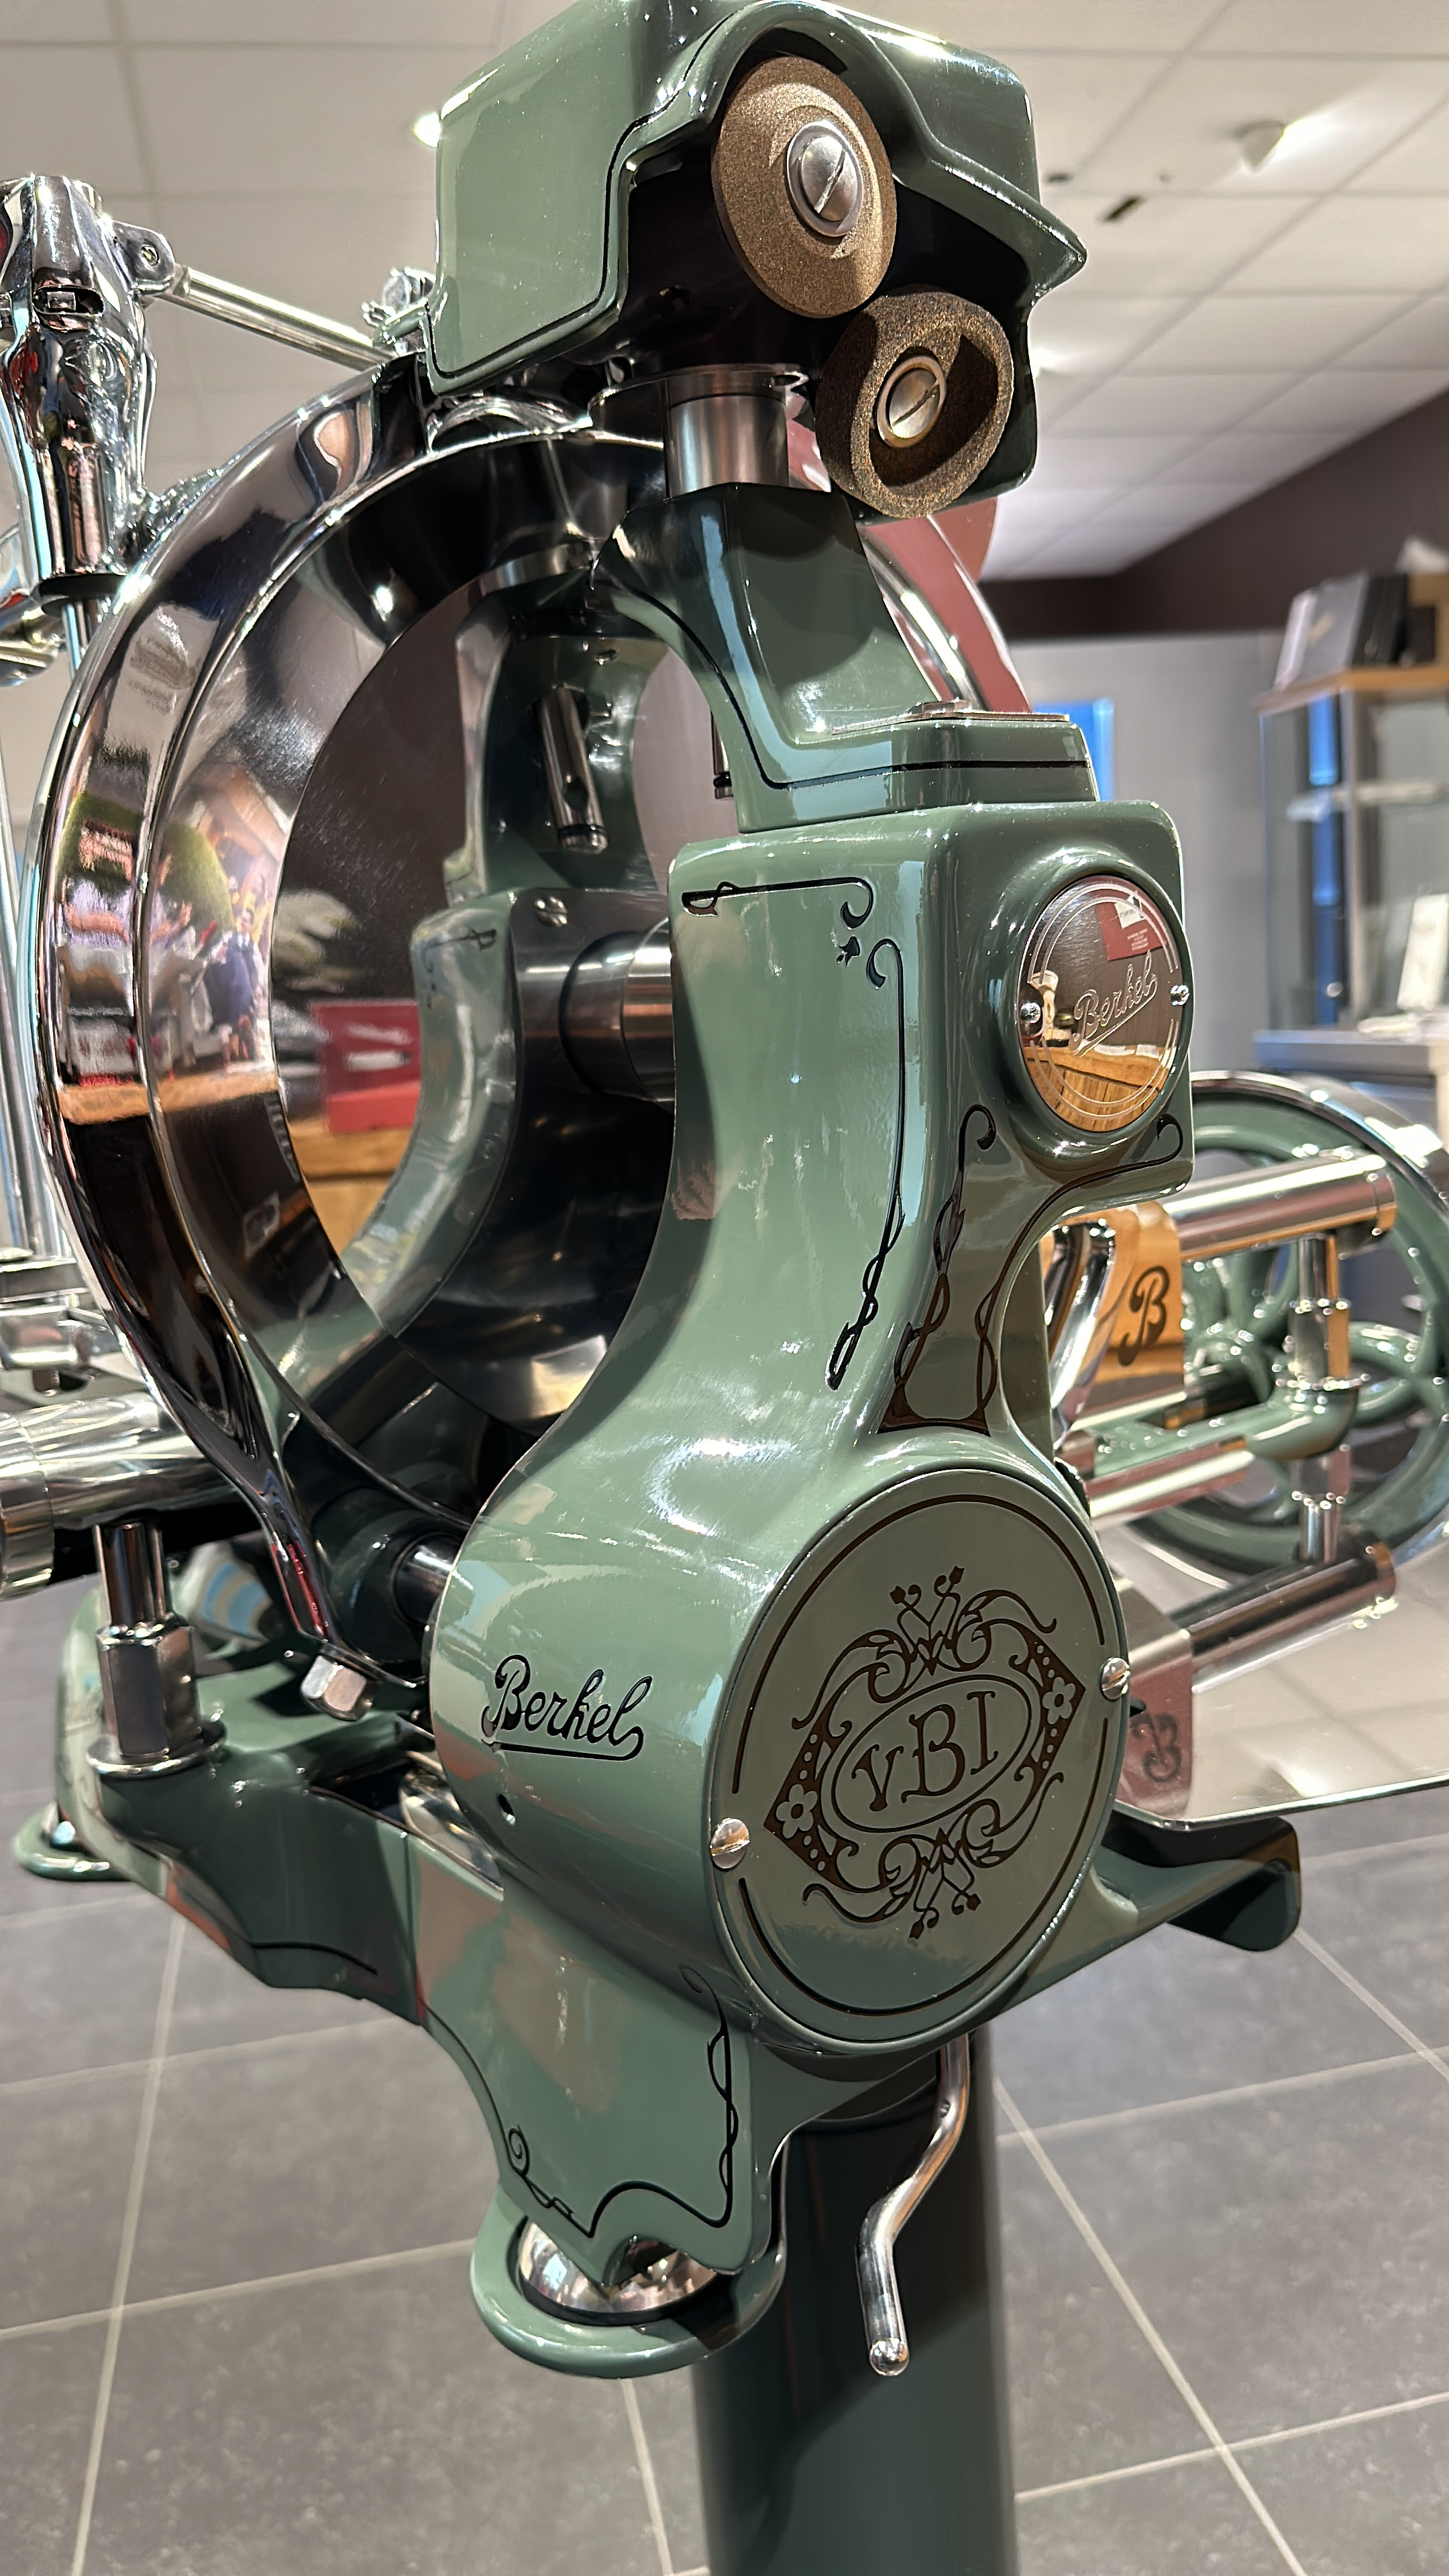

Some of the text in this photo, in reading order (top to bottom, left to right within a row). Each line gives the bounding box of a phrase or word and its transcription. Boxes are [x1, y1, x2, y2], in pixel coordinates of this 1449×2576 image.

[1069, 949, 1158, 1057] Berkel
[1117, 1265, 1170, 1366] B
[481, 1654, 653, 1761] Berkel
[851, 1689, 1000, 1812] VBI
